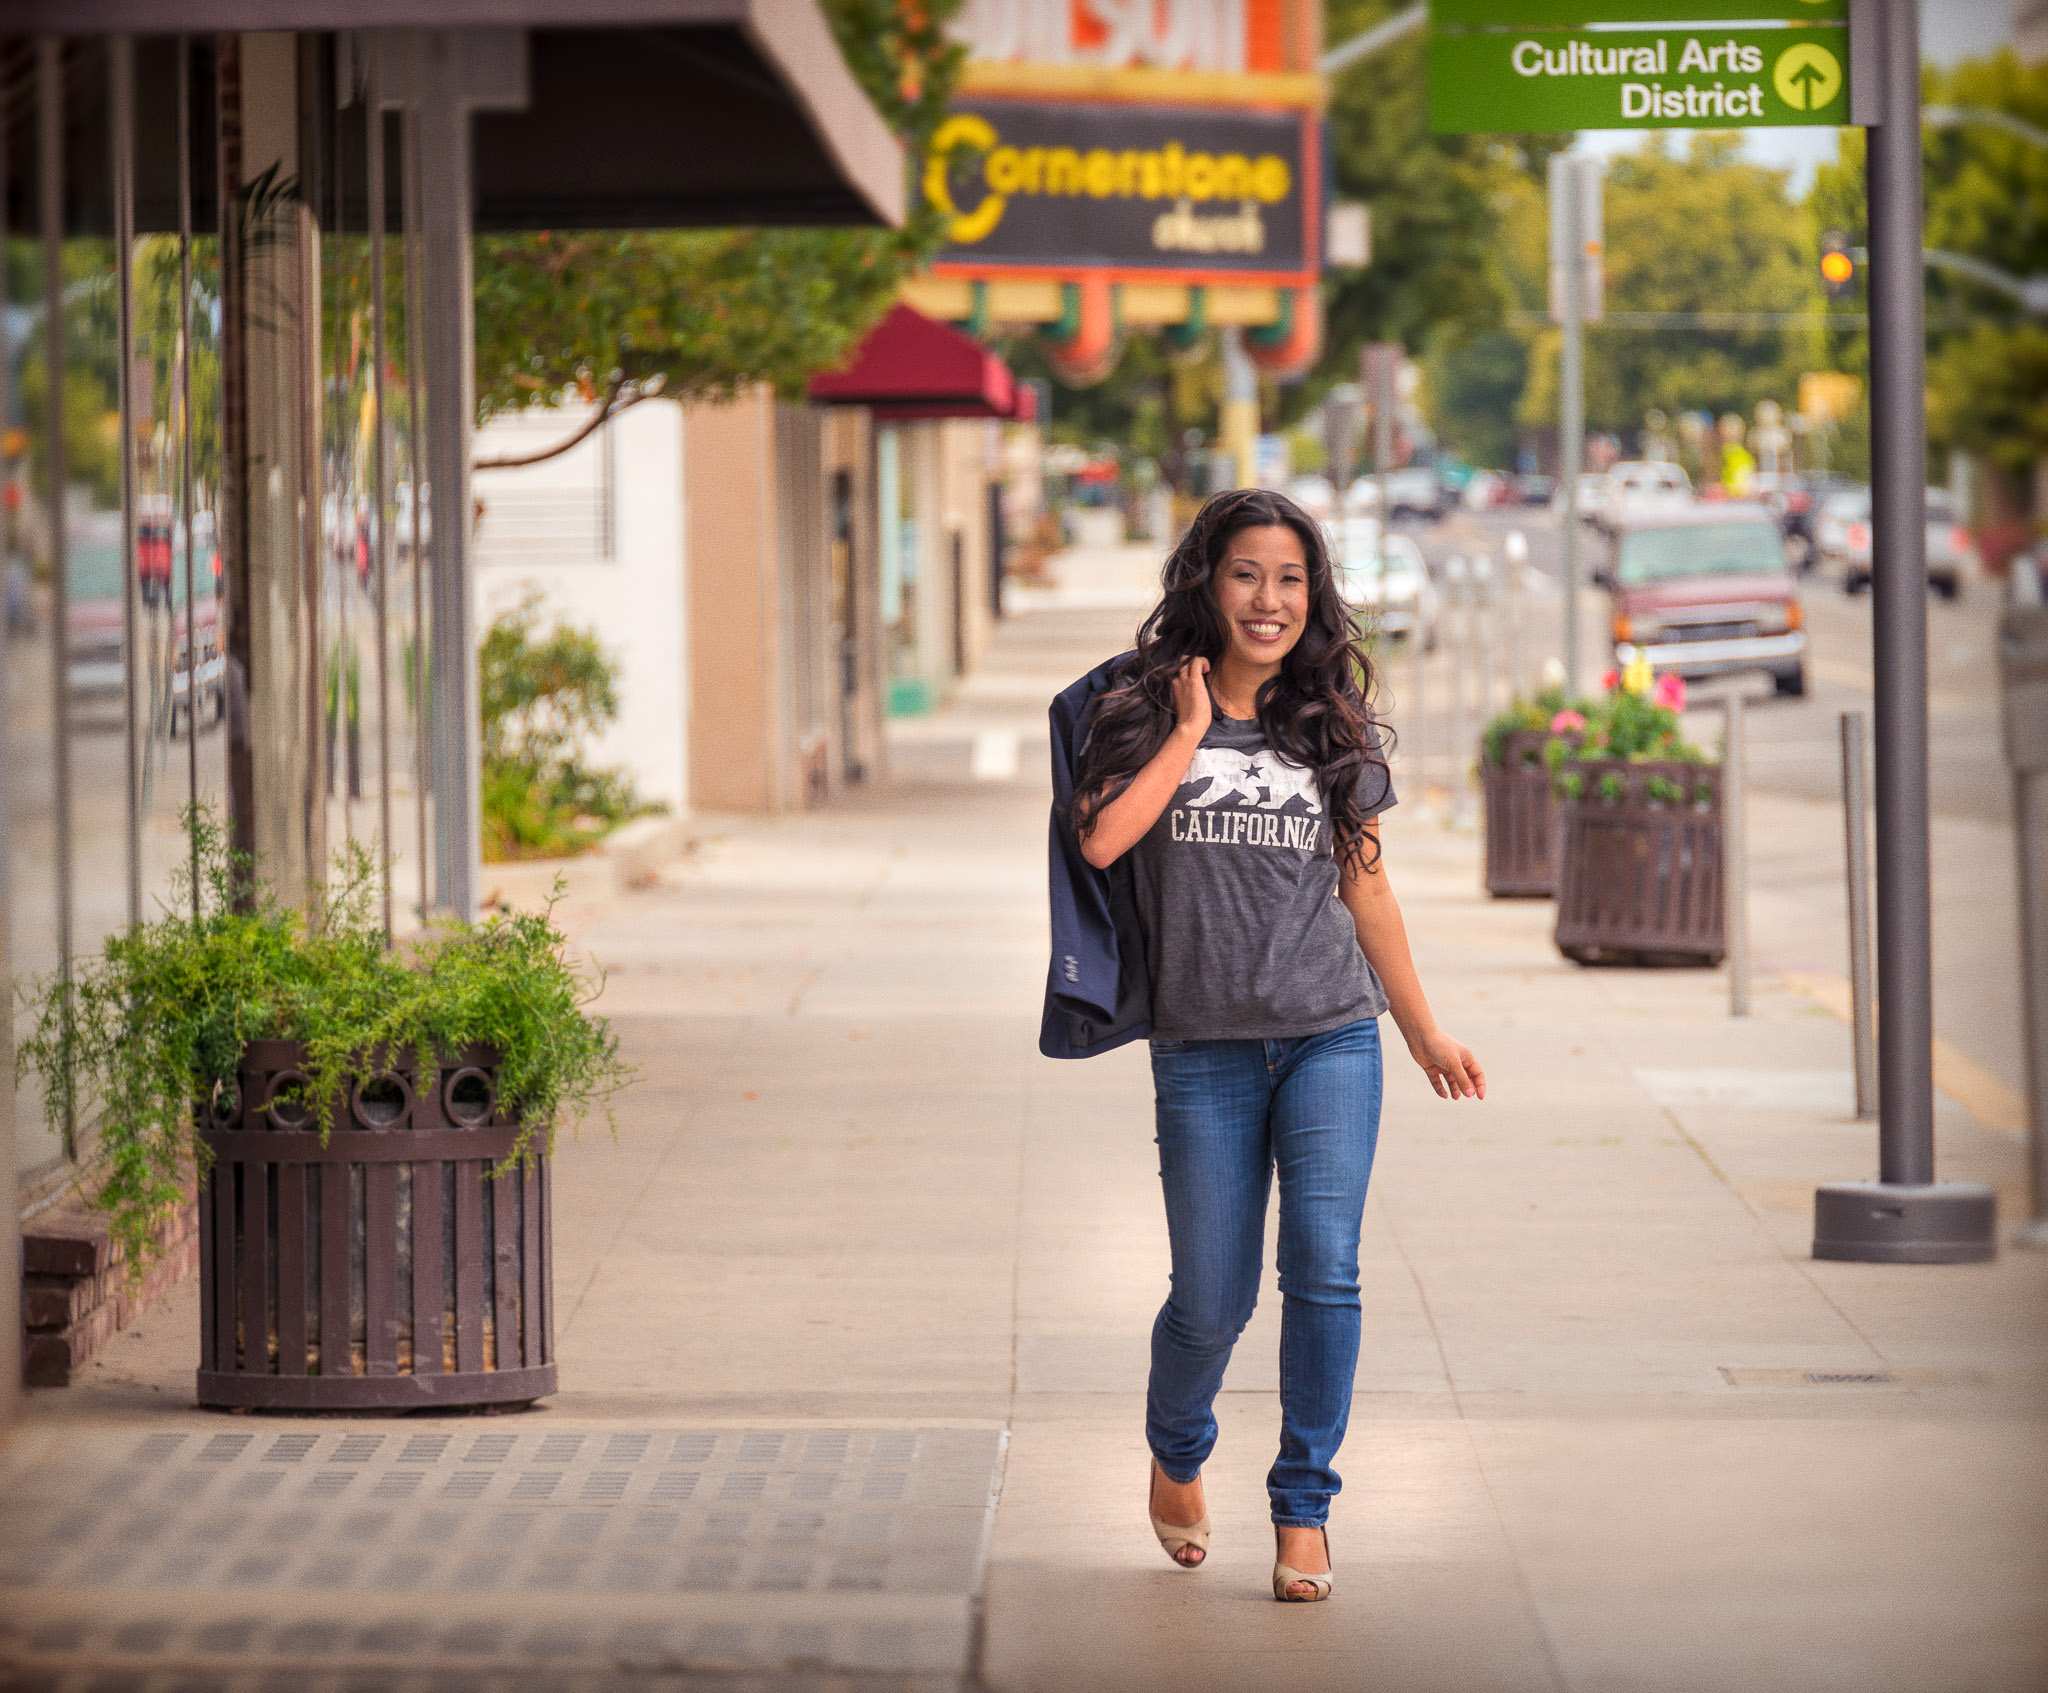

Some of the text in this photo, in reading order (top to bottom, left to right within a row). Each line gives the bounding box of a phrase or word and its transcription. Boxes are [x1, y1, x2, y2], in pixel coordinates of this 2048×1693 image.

[1511, 38, 1764, 77] Cultural Arts
[1621, 82, 1764, 119] District
[922, 114, 1291, 244] Cornerstone
[1171, 809, 1322, 851] CALIFORNIA
